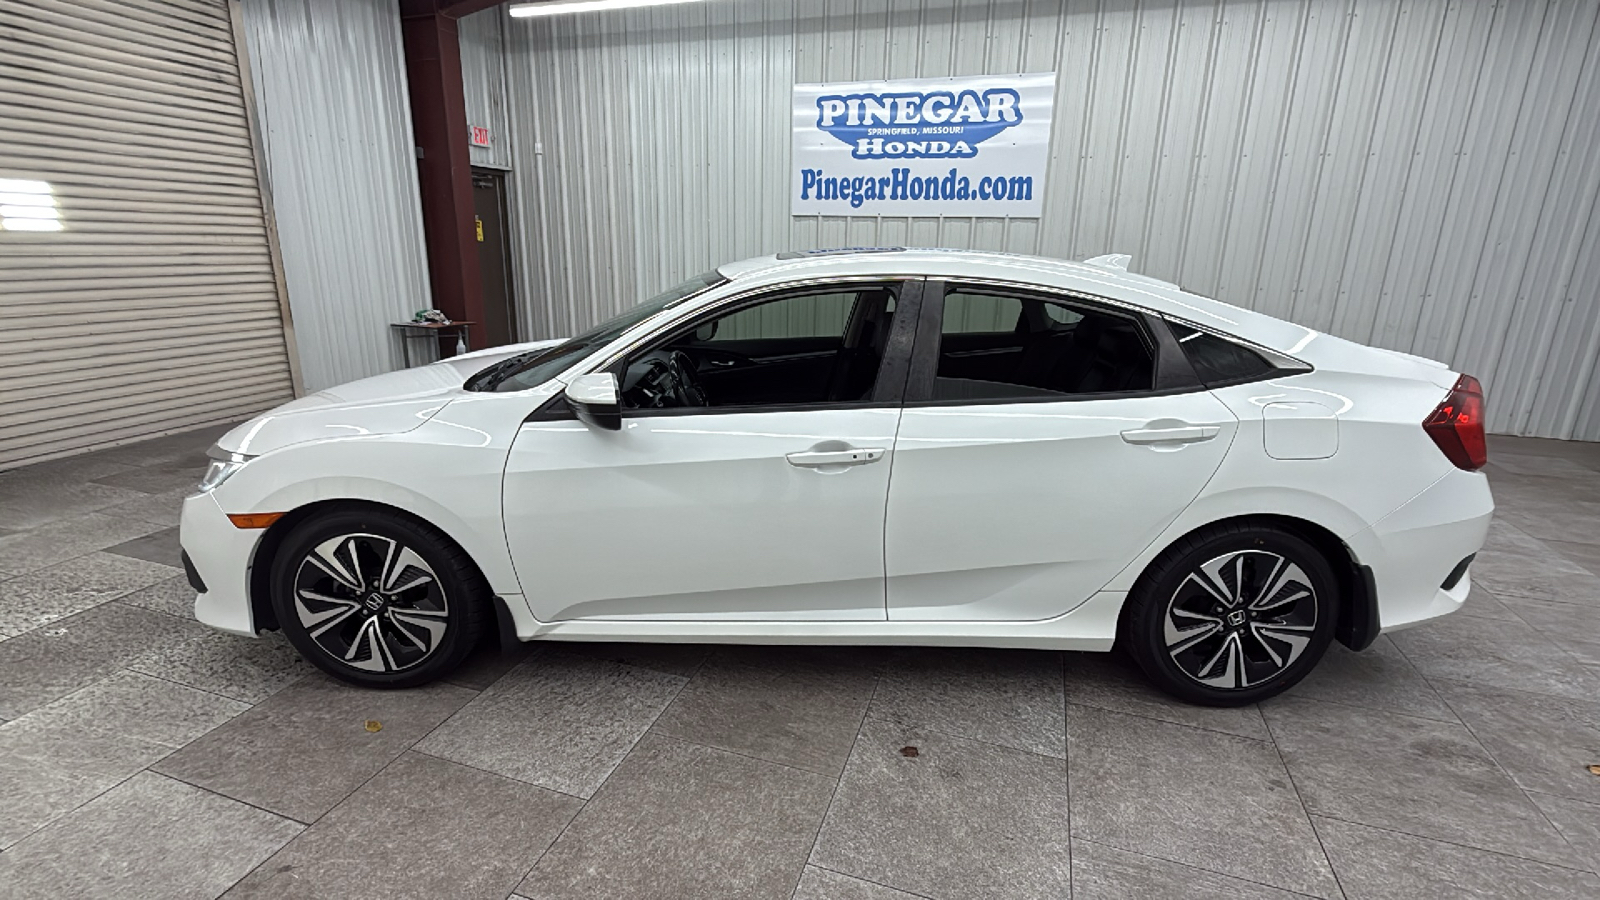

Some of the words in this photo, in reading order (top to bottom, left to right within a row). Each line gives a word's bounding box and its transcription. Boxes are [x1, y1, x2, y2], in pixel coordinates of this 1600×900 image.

[819, 92, 1019, 127] PINEGAR
[473, 126, 489, 145] EXIT
[867, 127, 921, 136] SPRINGFIELD,
[922, 126, 964, 135] MISSOURI
[856, 138, 974, 156] HONDA
[801, 168, 1033, 209] PinegarHonda.com
